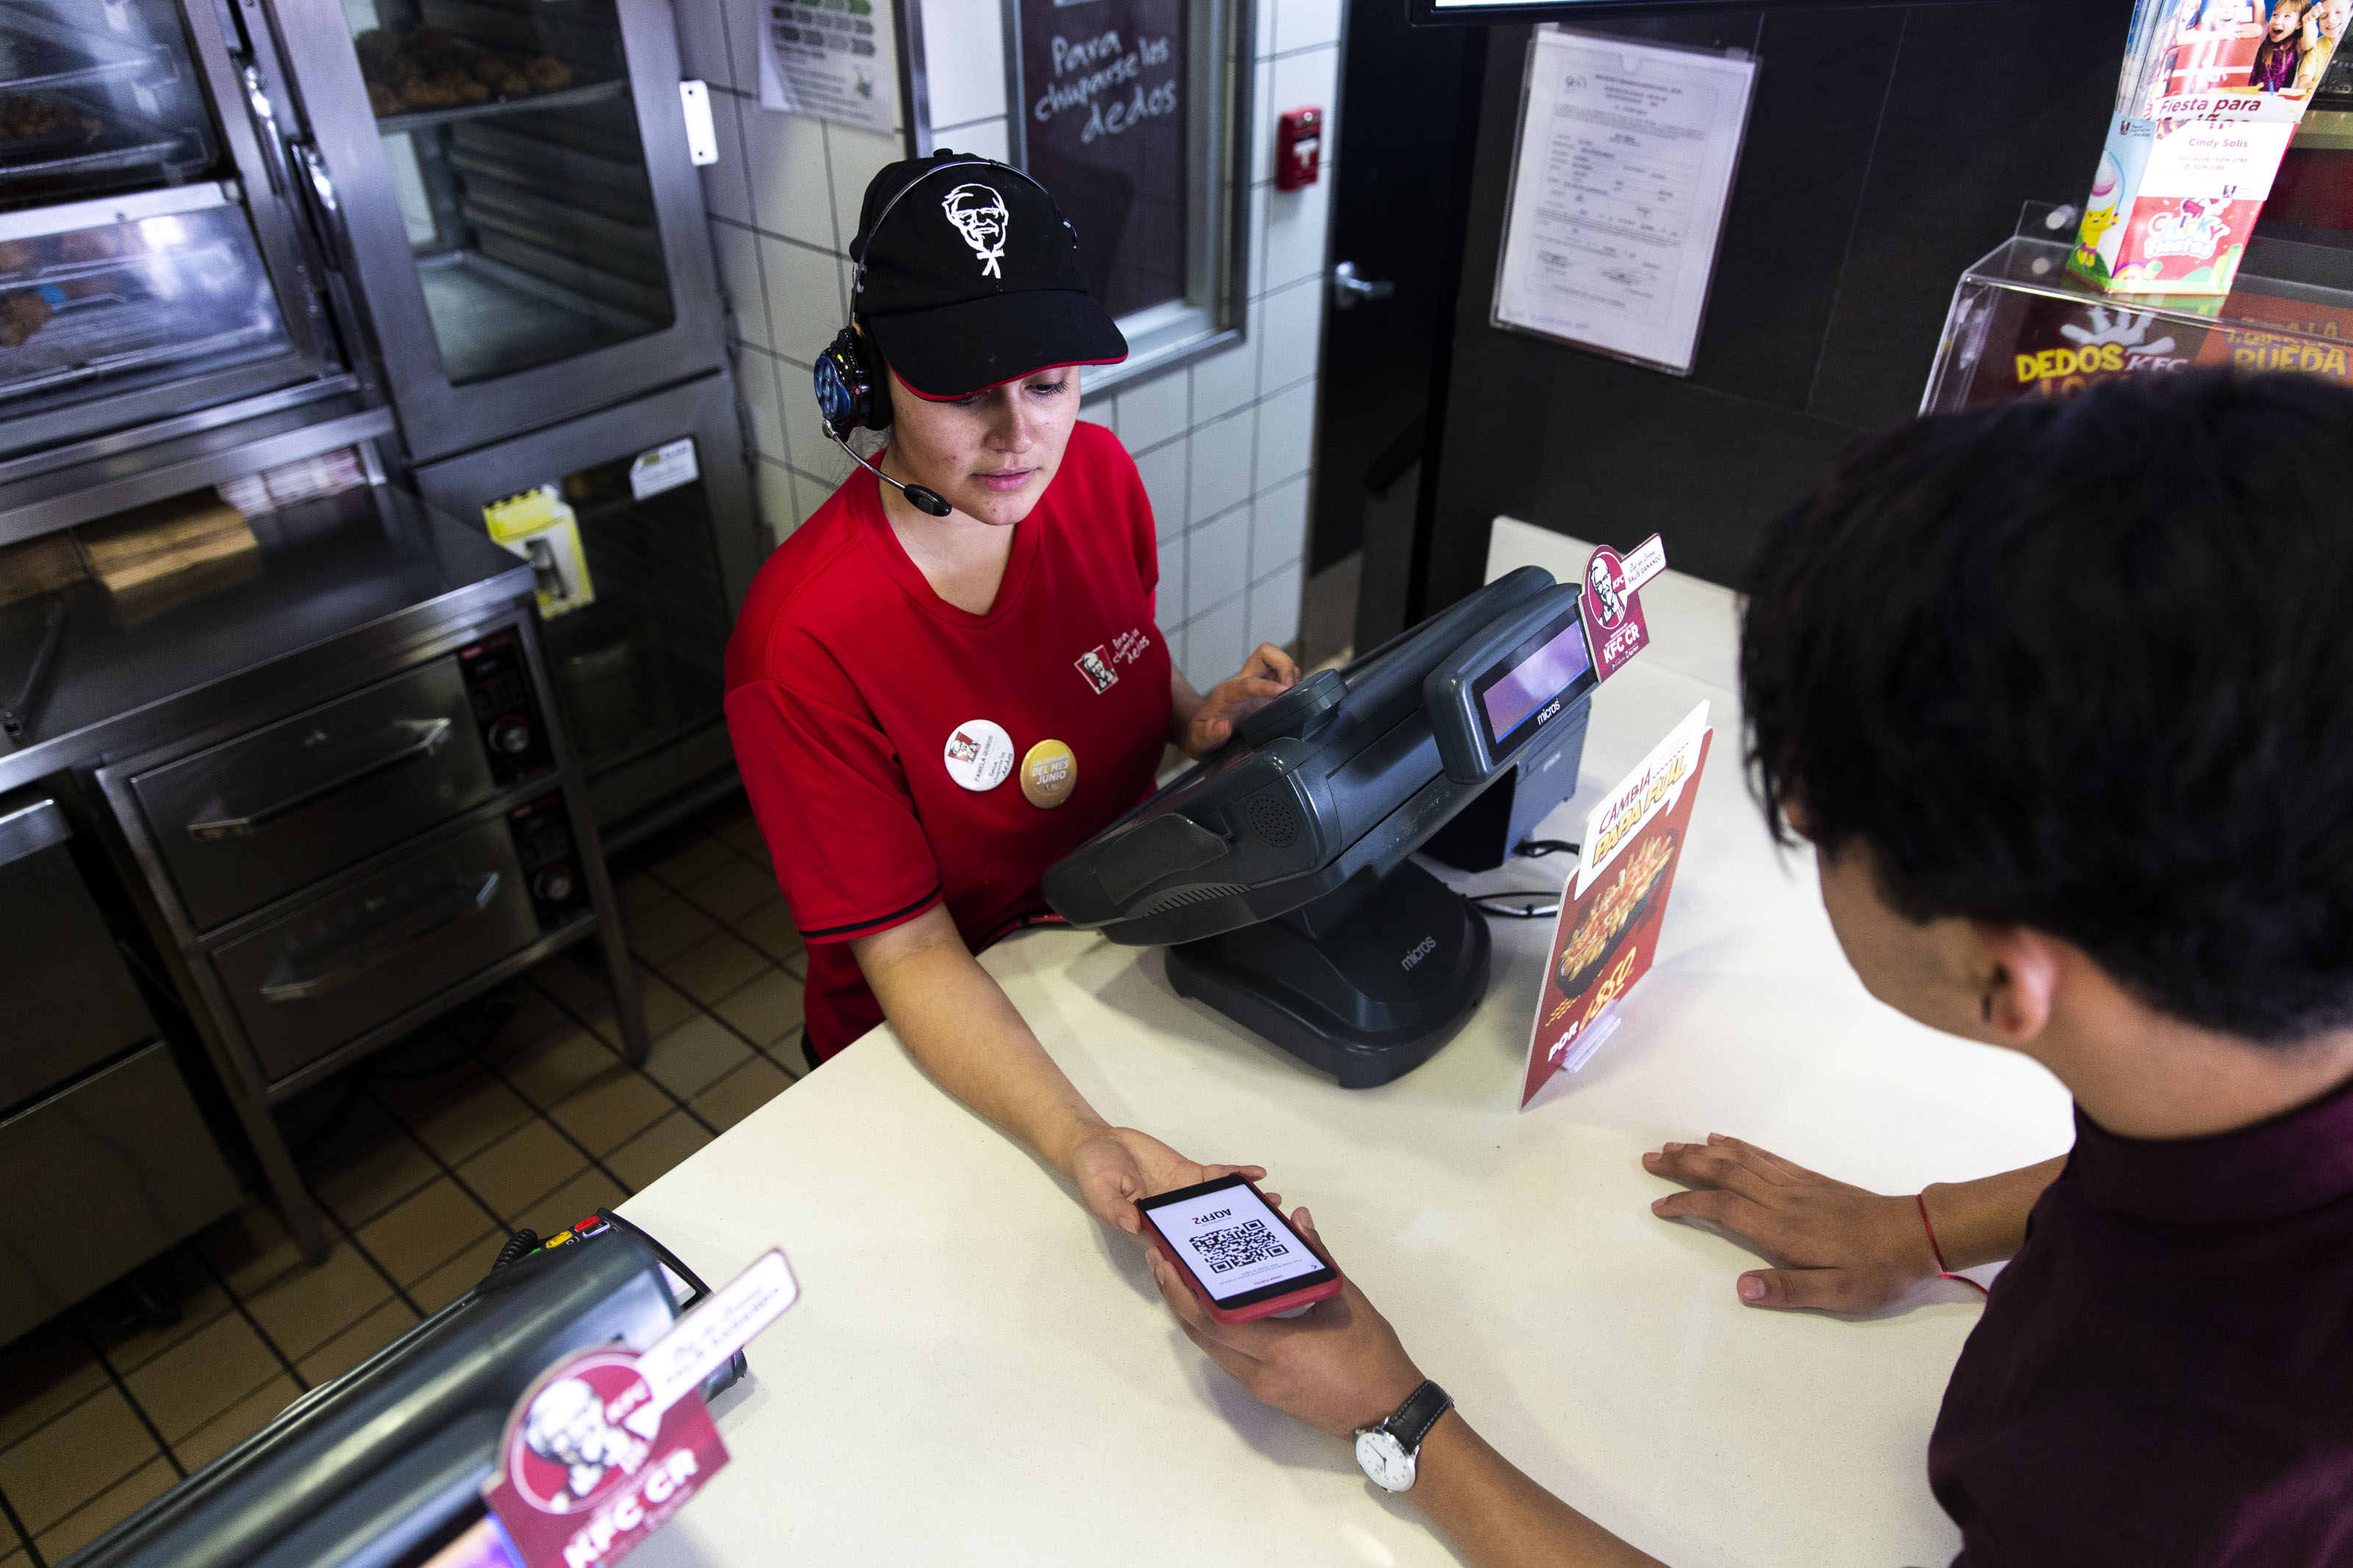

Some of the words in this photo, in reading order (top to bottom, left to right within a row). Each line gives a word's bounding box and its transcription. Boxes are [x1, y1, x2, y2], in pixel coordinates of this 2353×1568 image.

[1051, 29, 1122, 78] Para
[1034, 52, 1139, 121] chuparse
[1139, 37, 1170, 66] los
[1080, 79, 1176, 144] dedos
[2159, 97, 2208, 114] Fiesta
[2213, 99, 2262, 112] para
[2189, 138, 2218, 148] Cindy
[2015, 343, 2124, 383] DEDOS
[1613, 574, 1625, 591] KFC
[1603, 636, 1625, 664] KFC
[1625, 623, 1640, 645] CR
[1537, 700, 1560, 726] micros
[974, 757, 987, 782] PAMELA
[1032, 765, 1049, 777] DEL
[1051, 760, 1069, 773] MES
[1036, 770, 1067, 785] JUNIO
[1592, 800, 1642, 868] PAPA
[1643, 755, 1687, 815] FULL
[1599, 765, 1652, 834] CAMBIA
[1401, 936, 1436, 971] micros
[1548, 1020, 1579, 1062] POR
[1191, 1209, 1232, 1225] AQFP2
